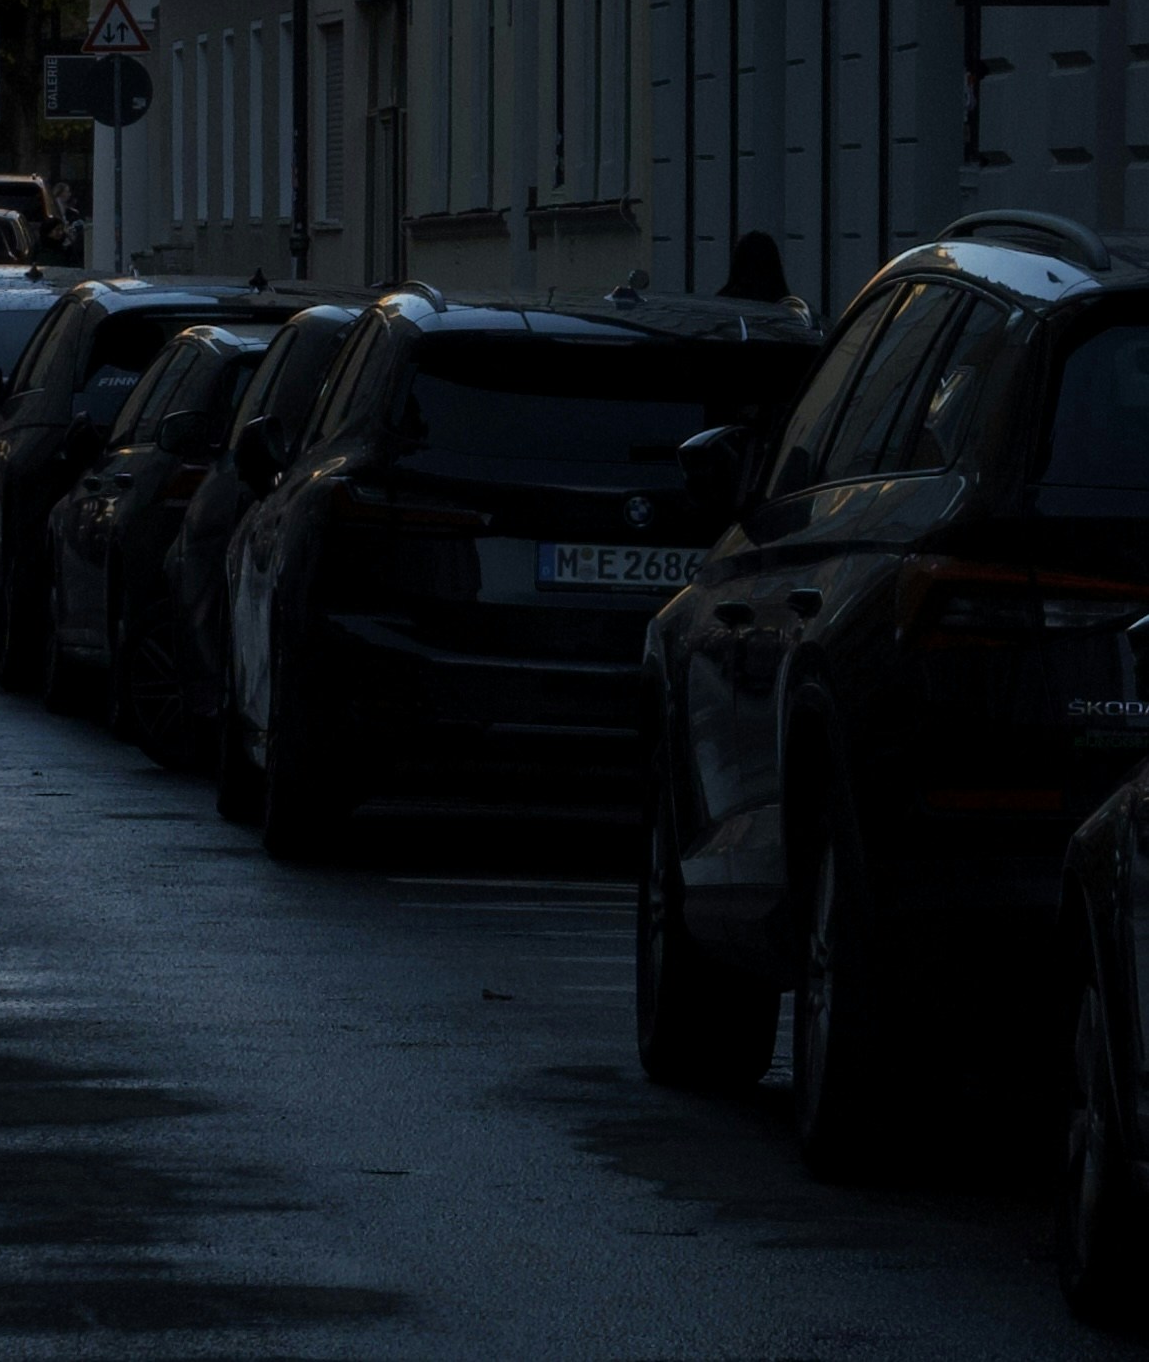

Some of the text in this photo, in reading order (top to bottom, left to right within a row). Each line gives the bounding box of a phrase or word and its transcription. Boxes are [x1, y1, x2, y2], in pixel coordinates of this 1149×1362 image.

[47, 58, 58, 109] GALERIE
[98, 377, 139, 387] FINN
[557, 548, 700, 582] M E 2686
